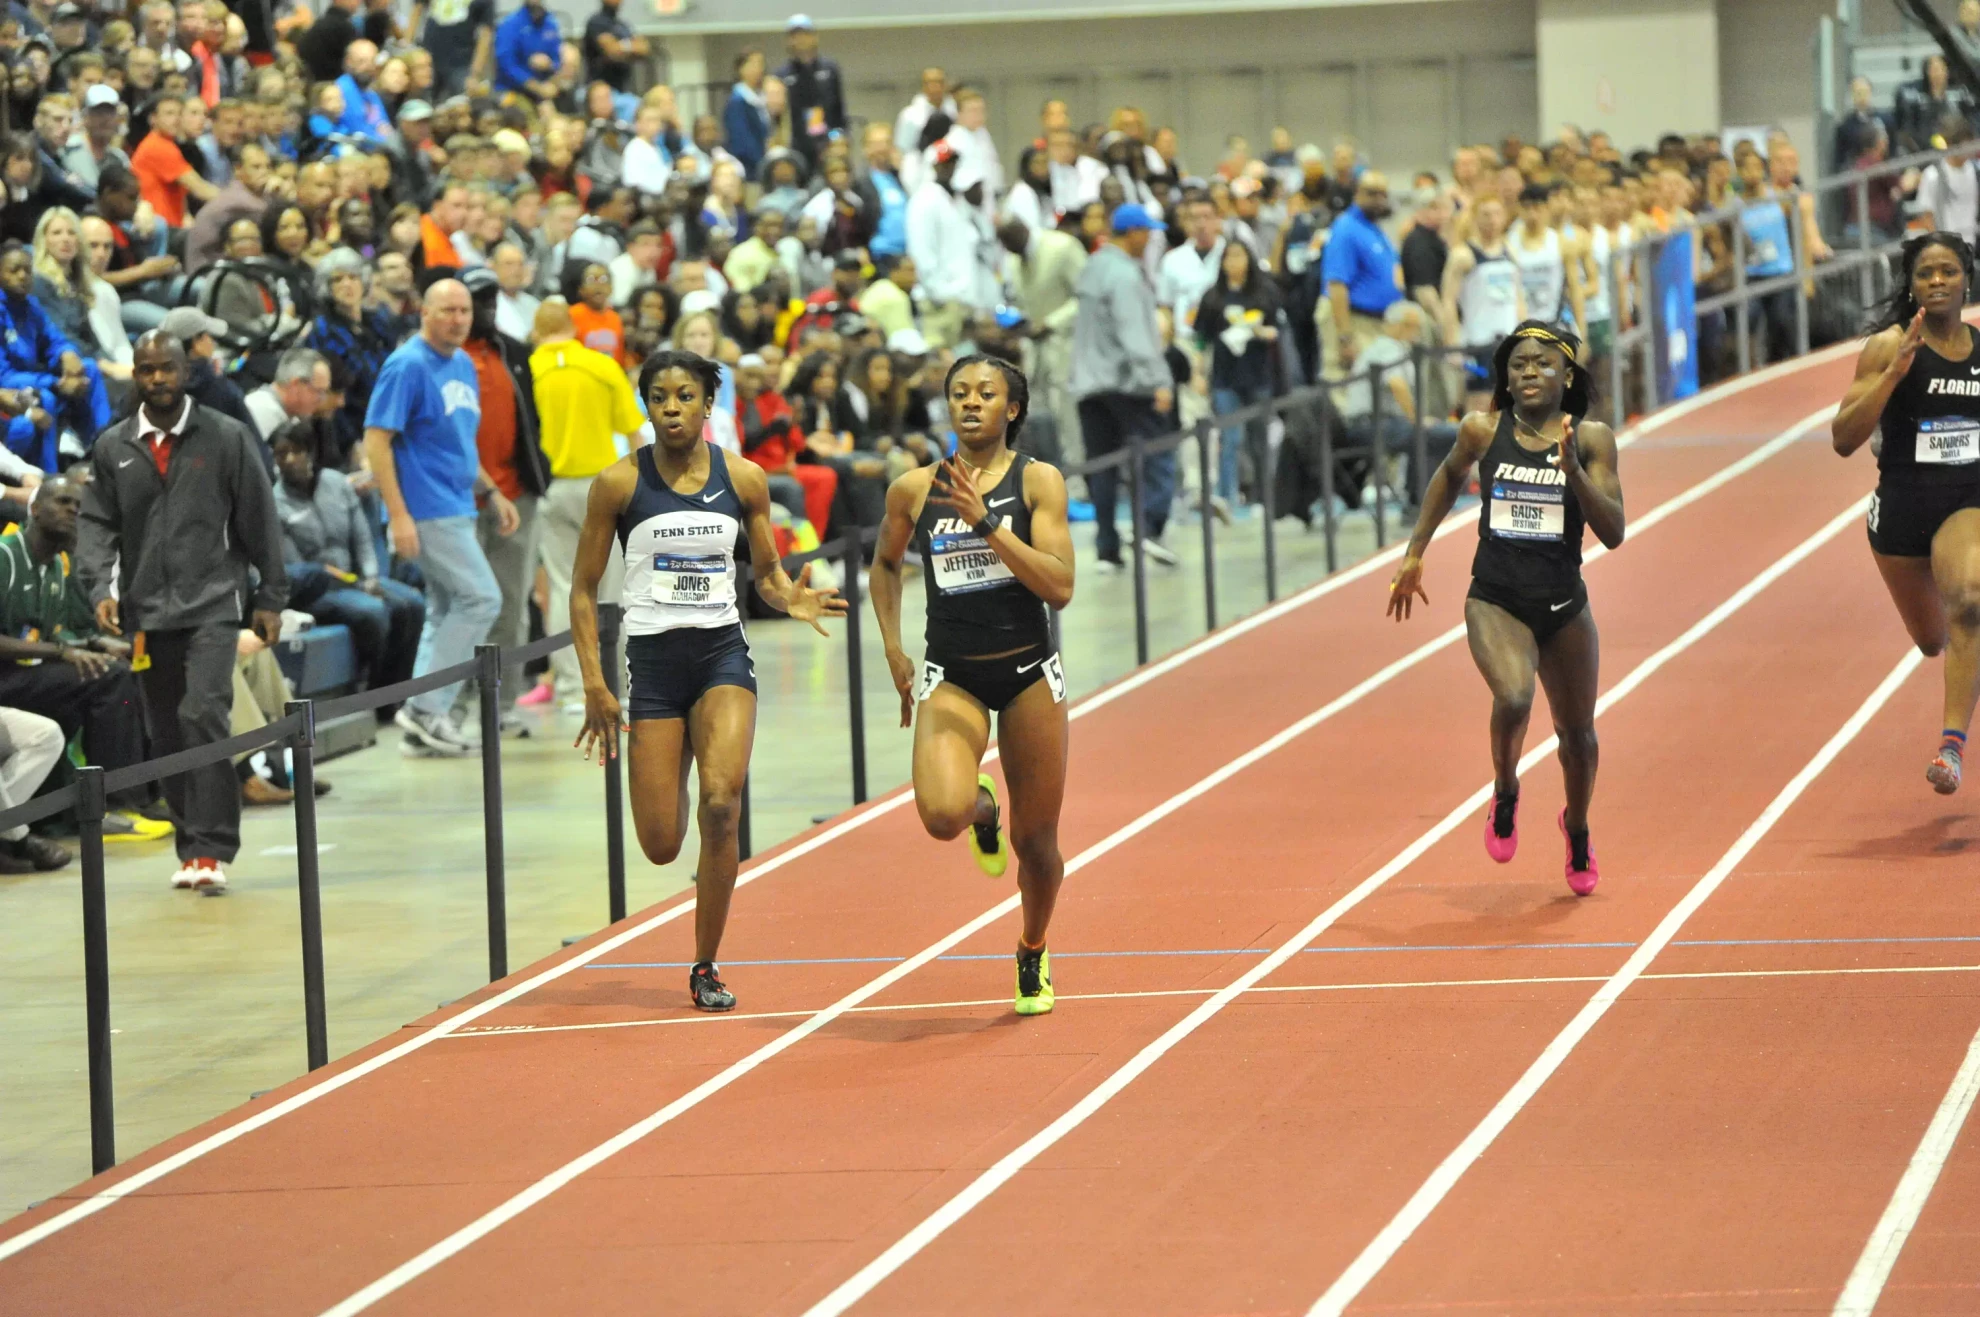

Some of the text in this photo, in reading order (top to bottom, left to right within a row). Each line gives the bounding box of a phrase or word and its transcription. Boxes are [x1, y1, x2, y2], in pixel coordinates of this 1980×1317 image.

[1927, 378, 1980, 396] FLORID
[1929, 434, 1970, 449] SANDERS
[1494, 463, 1566, 487] FLORIDA
[1511, 504, 1545, 520] GAUSE
[653, 525, 723, 538] PENN STATE
[1512, 519, 1542, 530] DESTINEE
[966, 568, 986, 580] KYRA
[673, 575, 710, 592] JONES
[1050, 659, 1064, 698] 5
